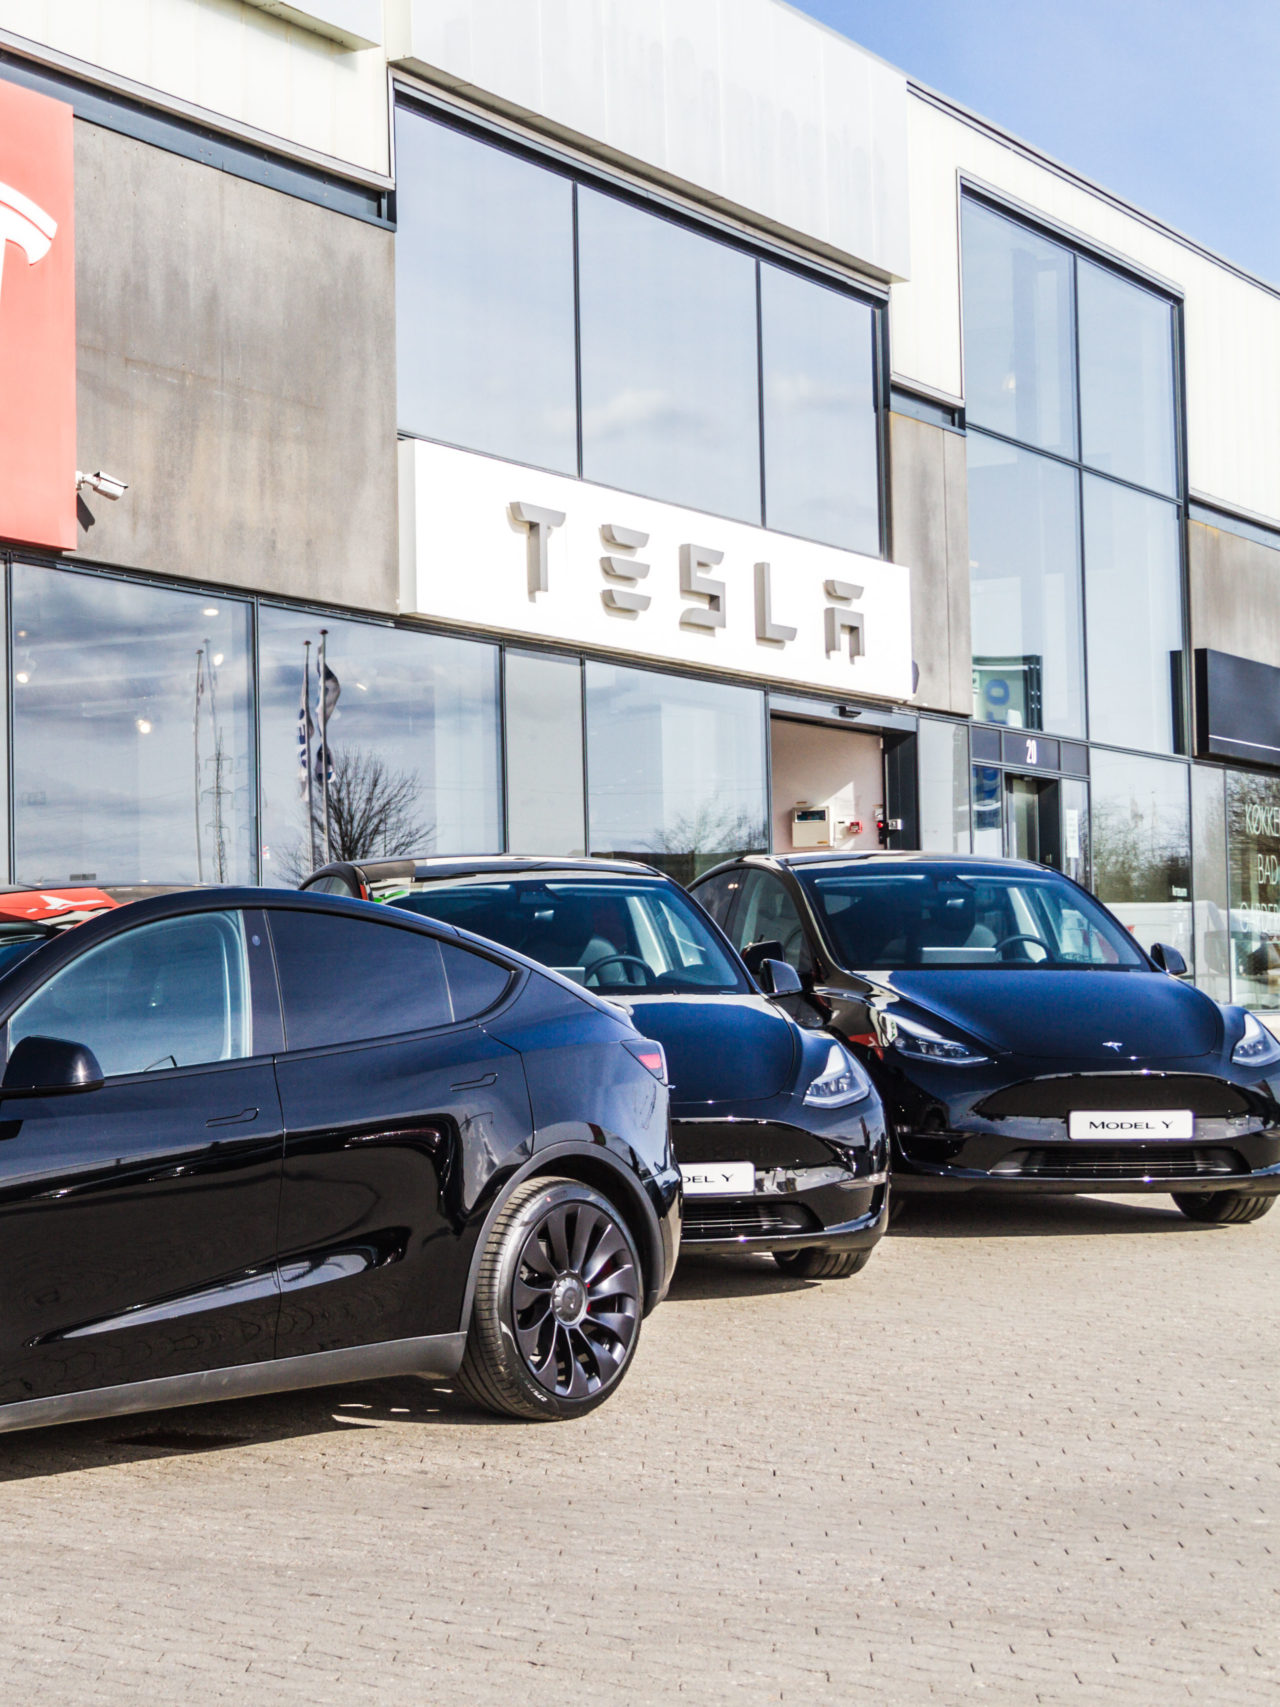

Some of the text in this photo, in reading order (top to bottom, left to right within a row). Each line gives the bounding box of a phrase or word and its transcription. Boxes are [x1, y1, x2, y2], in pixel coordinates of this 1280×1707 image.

[506, 501, 866, 665] TESLA
[1025, 739, 1038, 765] 20
[1257, 853, 1279, 886] BAD
[1089, 1120, 1174, 1130] MODEL Y
[682, 1173, 734, 1184] DEL Y
